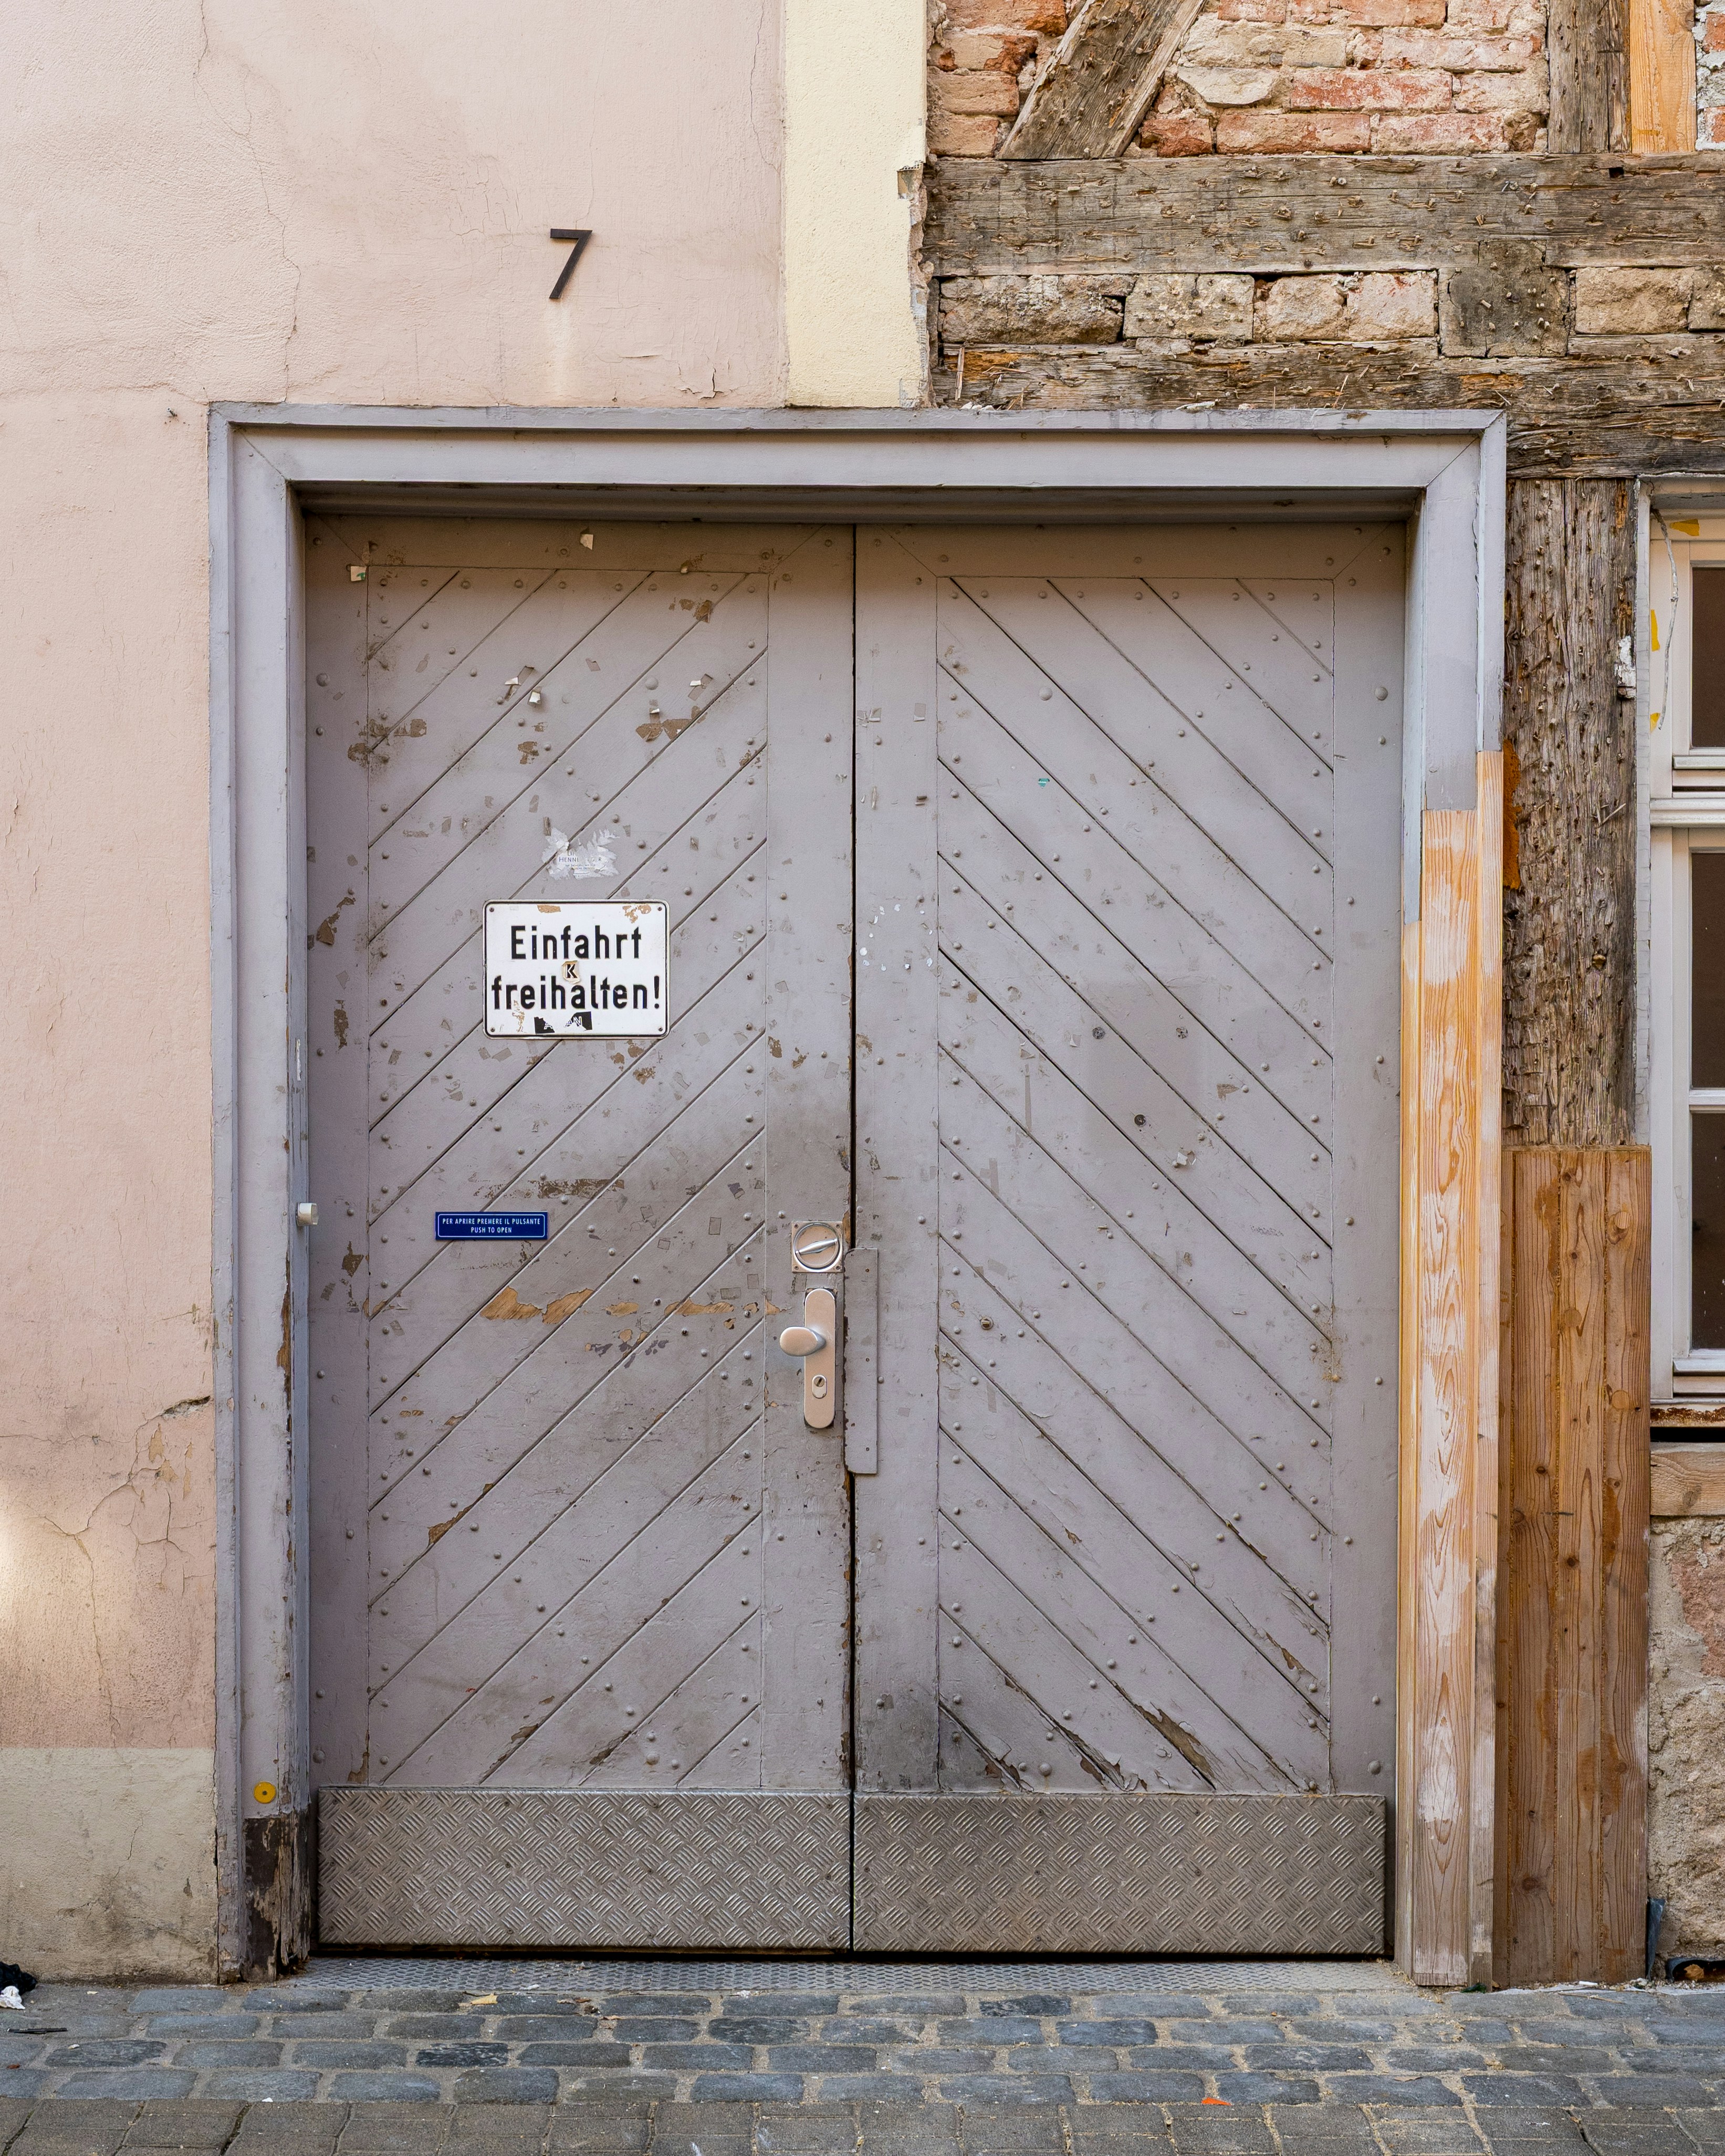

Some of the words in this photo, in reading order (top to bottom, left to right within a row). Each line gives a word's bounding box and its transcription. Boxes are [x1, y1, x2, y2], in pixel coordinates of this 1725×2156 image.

[549, 229, 592, 300] 7
[511, 925, 641, 959] Einfahrt
[492, 975, 659, 1009] freihalten!
